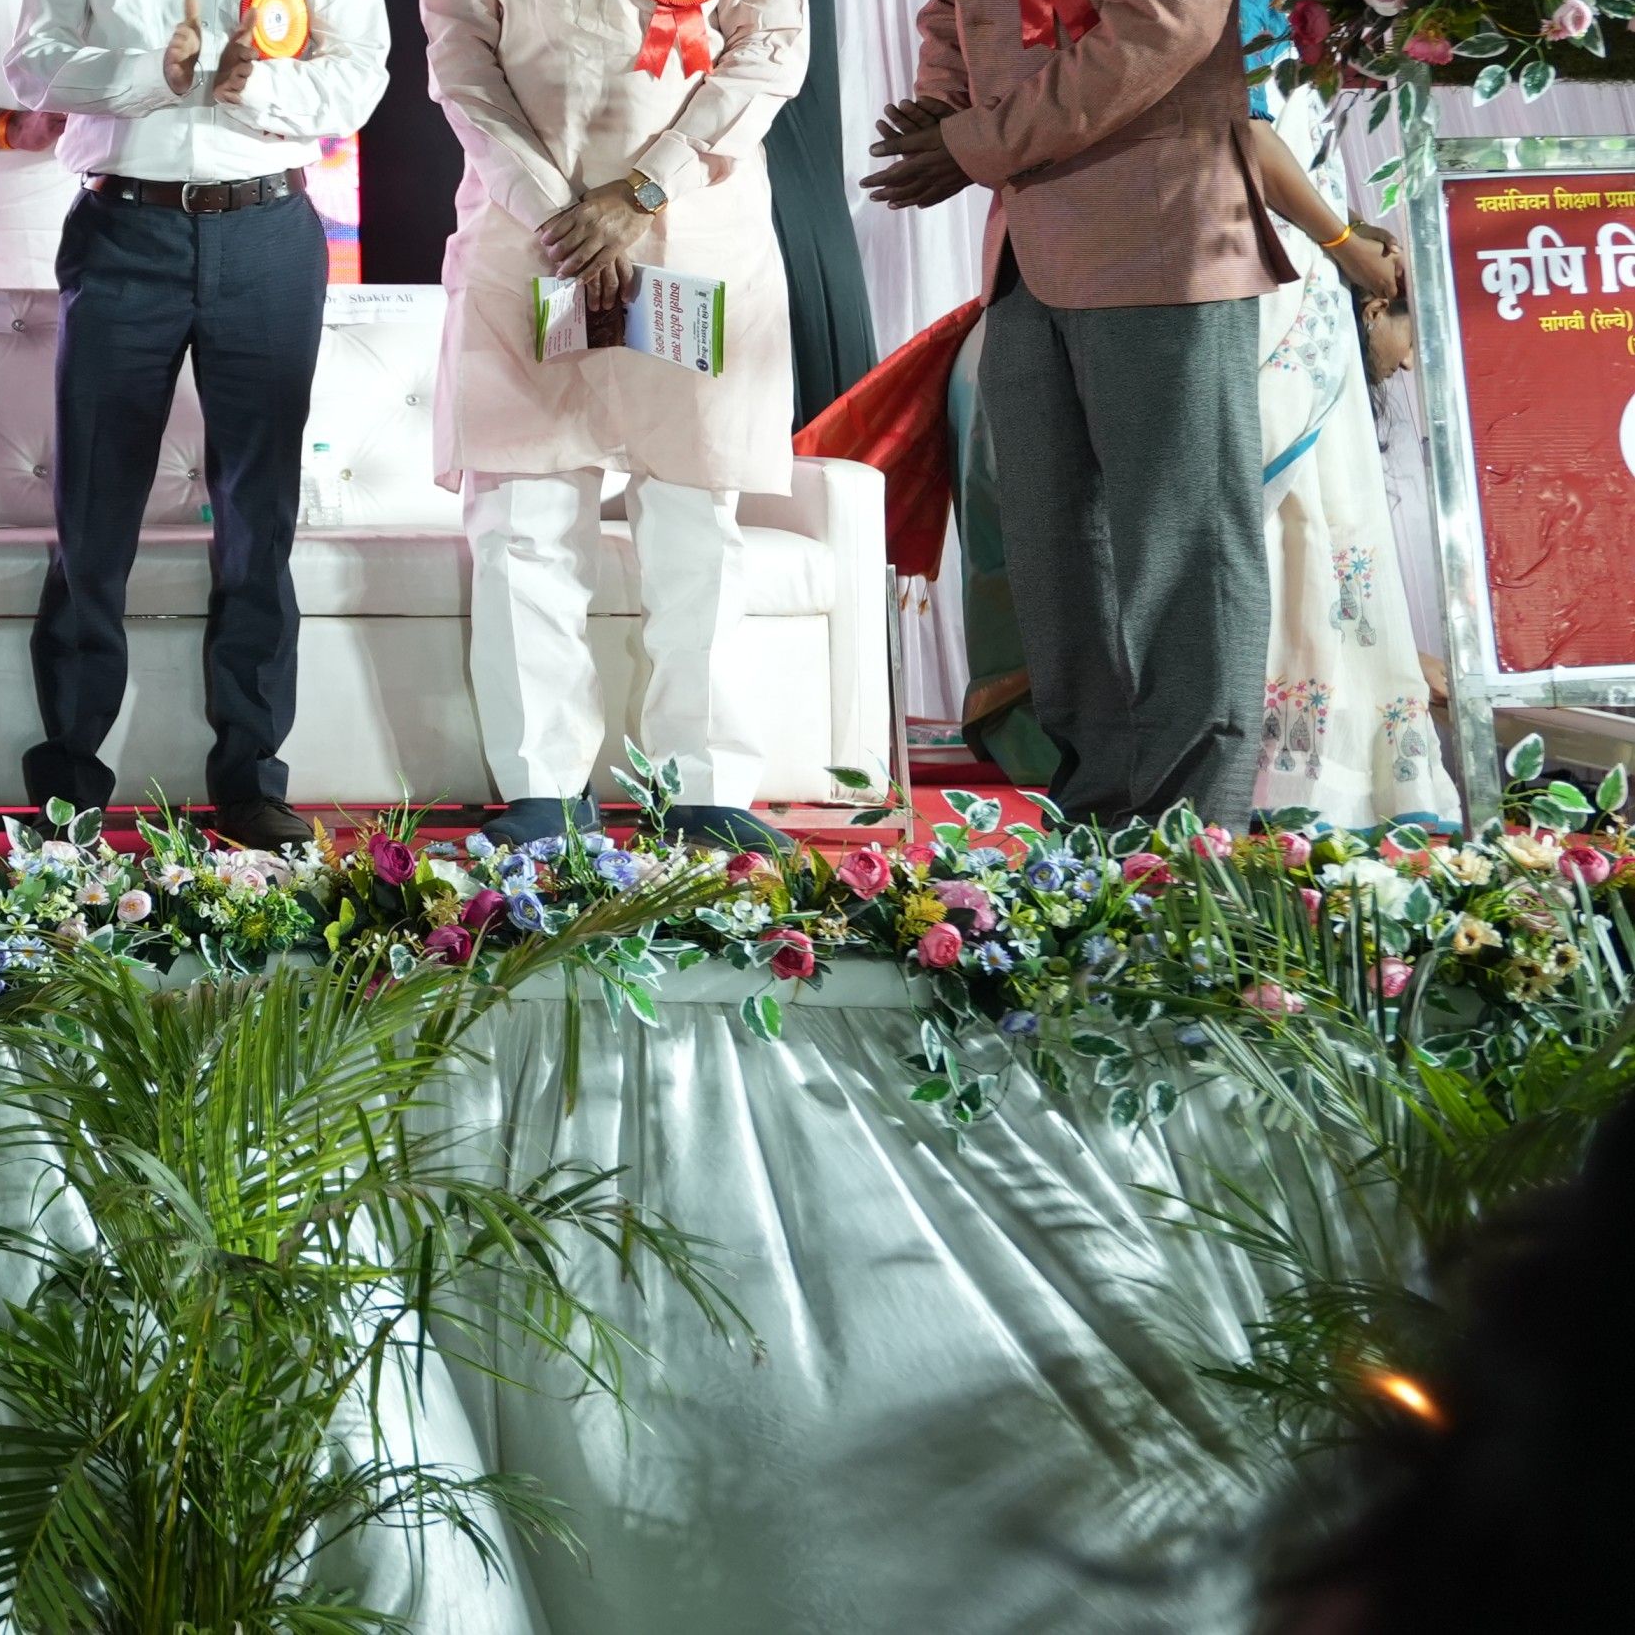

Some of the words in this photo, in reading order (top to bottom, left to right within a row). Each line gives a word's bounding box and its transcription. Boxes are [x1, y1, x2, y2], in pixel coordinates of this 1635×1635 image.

[1474, 188, 1550, 212] नवसंजिवन
[1553, 186, 1601, 212] शिक्षण
[1604, 190, 1635, 209] प्रसा
[1475, 224, 1589, 321] कृषि
[348, 293, 392, 305] Shakir
[395, 293, 414, 304] Ali
[1538, 309, 1585, 333] सांगवी
[1590, 306, 1635, 334] (रेल्वे)
